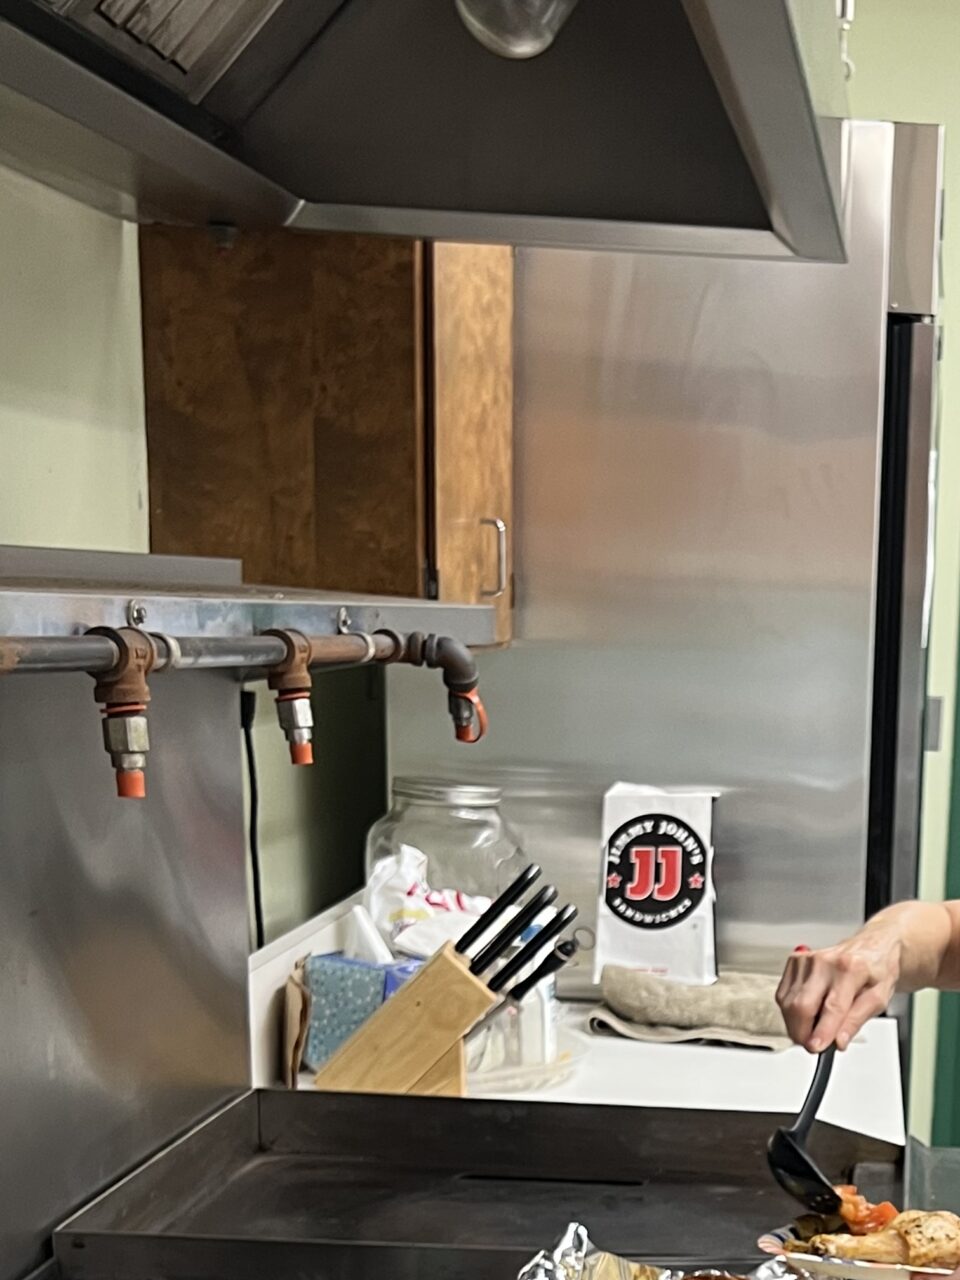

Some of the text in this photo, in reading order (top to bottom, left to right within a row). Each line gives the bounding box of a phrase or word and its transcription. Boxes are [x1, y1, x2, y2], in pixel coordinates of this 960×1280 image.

[608, 820, 704, 865] JIMMY JOHN'S
[625, 845, 683, 902] JJ
